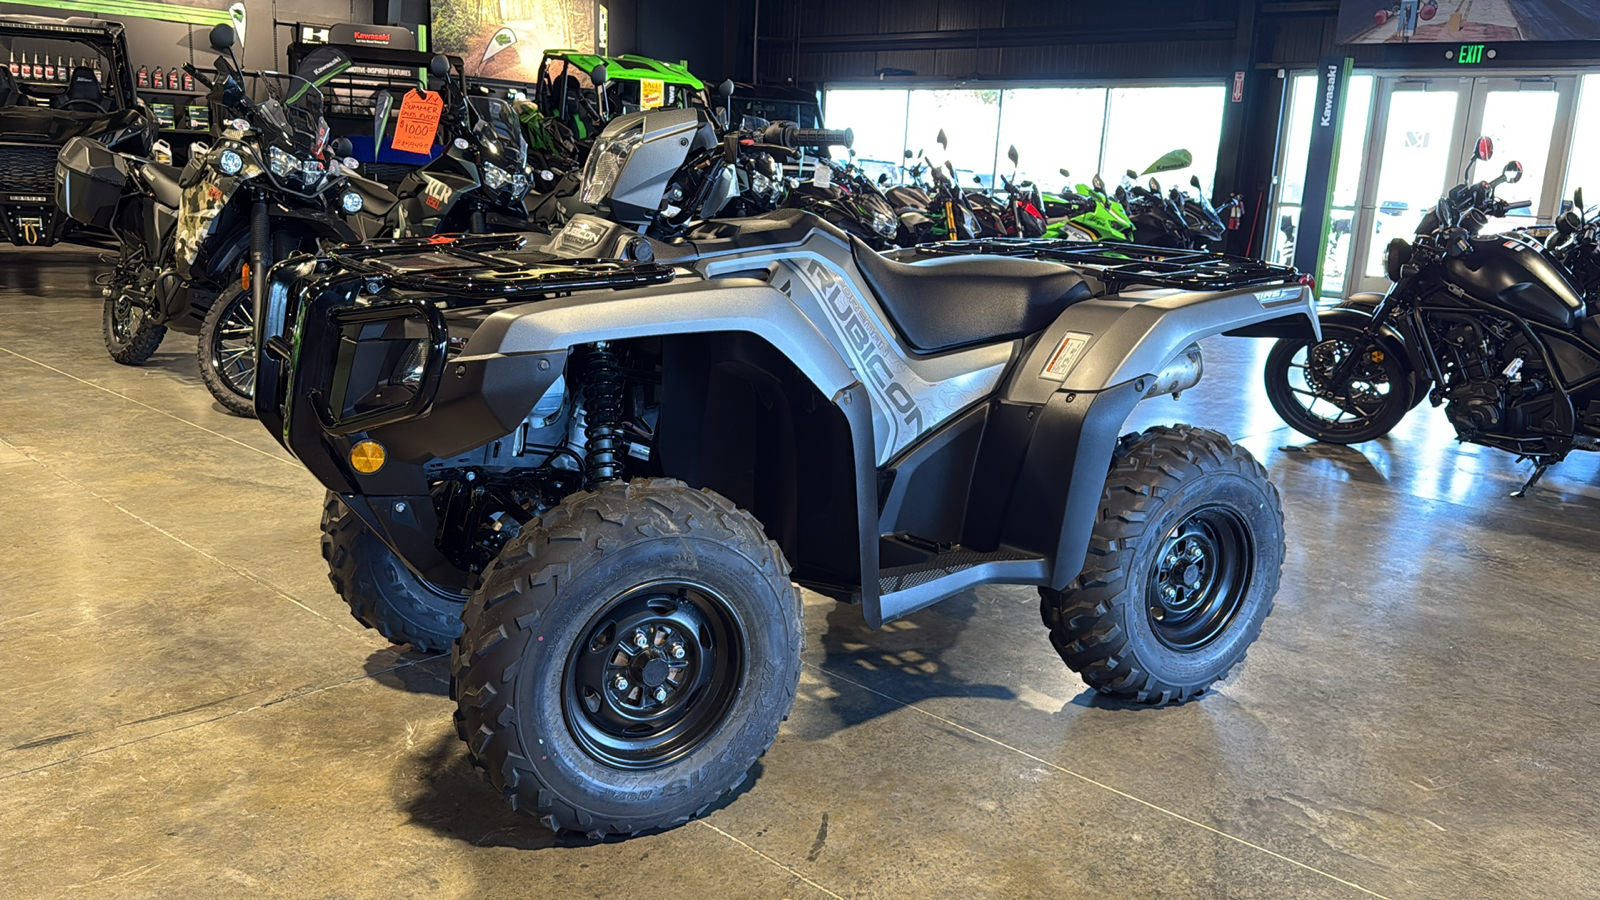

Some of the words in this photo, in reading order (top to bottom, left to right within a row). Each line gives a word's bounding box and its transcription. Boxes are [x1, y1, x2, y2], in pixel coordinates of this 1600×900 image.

[313, 55, 342, 76] Kawasaki
[1458, 45, 1486, 64] EXIT
[1320, 65, 1338, 127] Kawasaki
[403, 101, 439, 116] SUMMER
[424, 179, 453, 205] KLR
[806, 259, 924, 438] RUBICON
